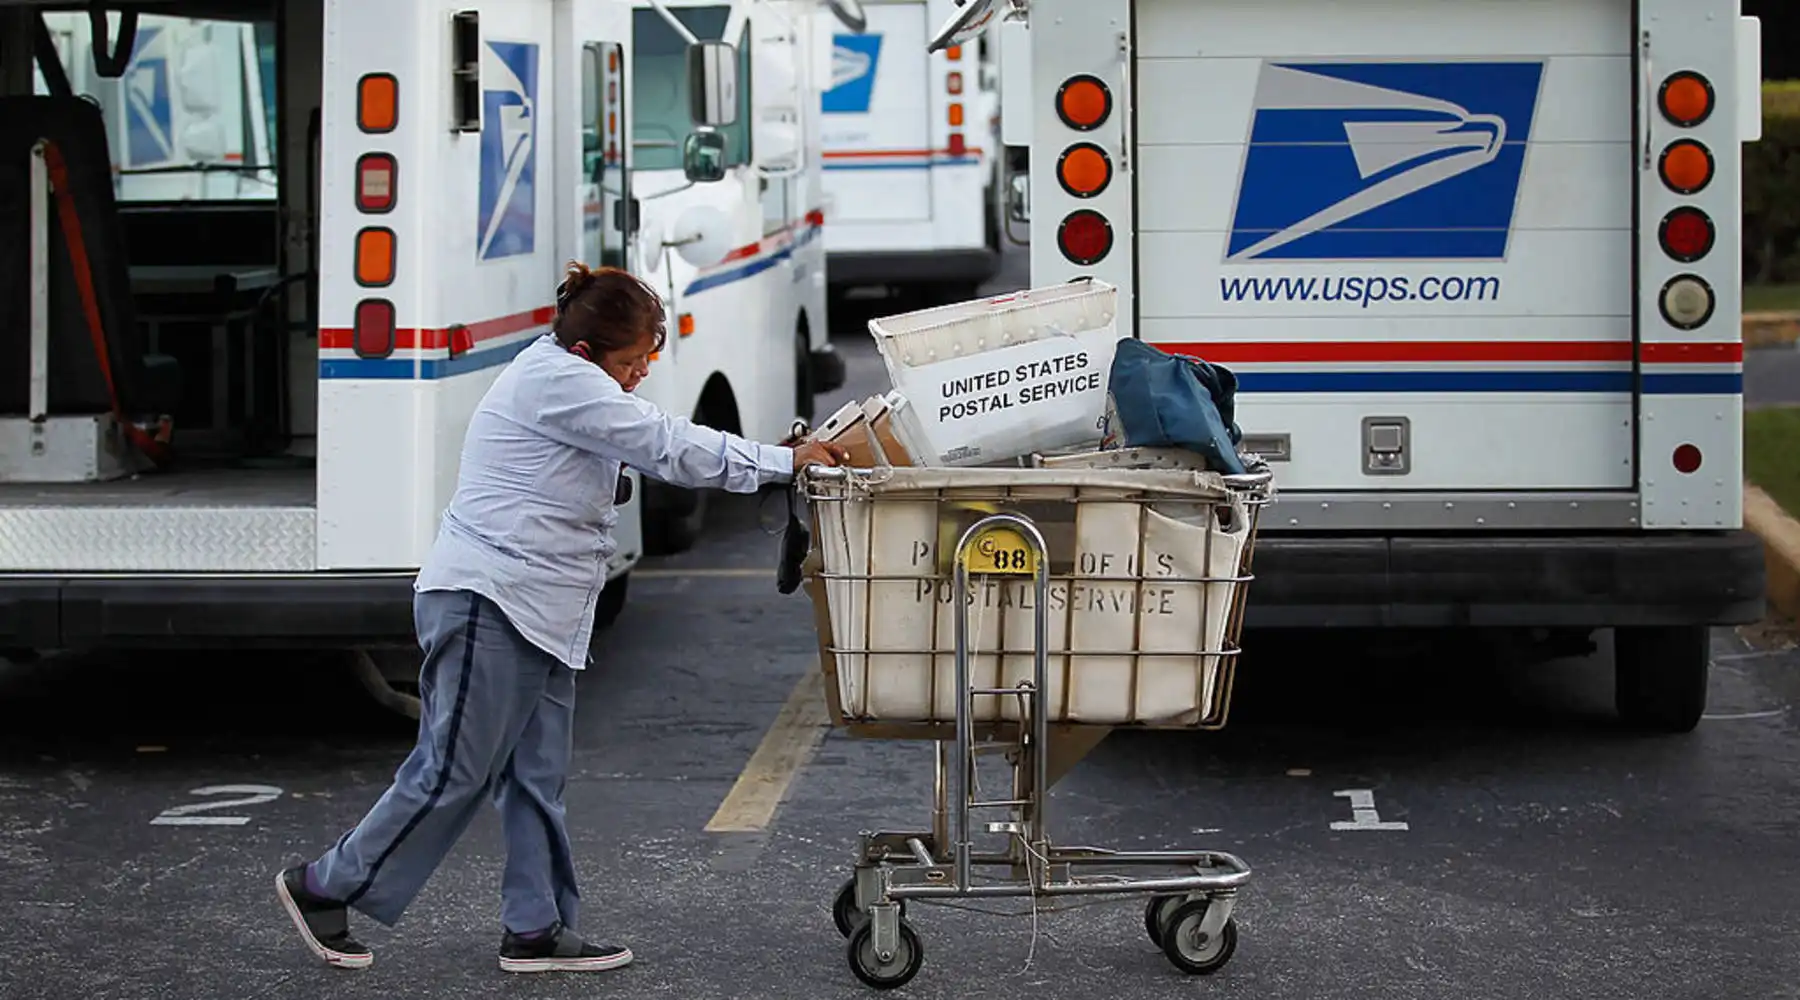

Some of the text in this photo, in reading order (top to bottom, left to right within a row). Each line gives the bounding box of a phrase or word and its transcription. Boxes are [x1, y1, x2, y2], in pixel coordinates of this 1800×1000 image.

[1220, 276, 1500, 308] www.usps.com
[942, 352, 1088, 398] UNITED STATES
[939, 373, 1099, 422] POSTAL SERVICE
[994, 549, 1025, 569] 88
[1080, 553, 1114, 575] OF
[149, 784, 283, 825] 2
[1329, 789, 1408, 830] 1
